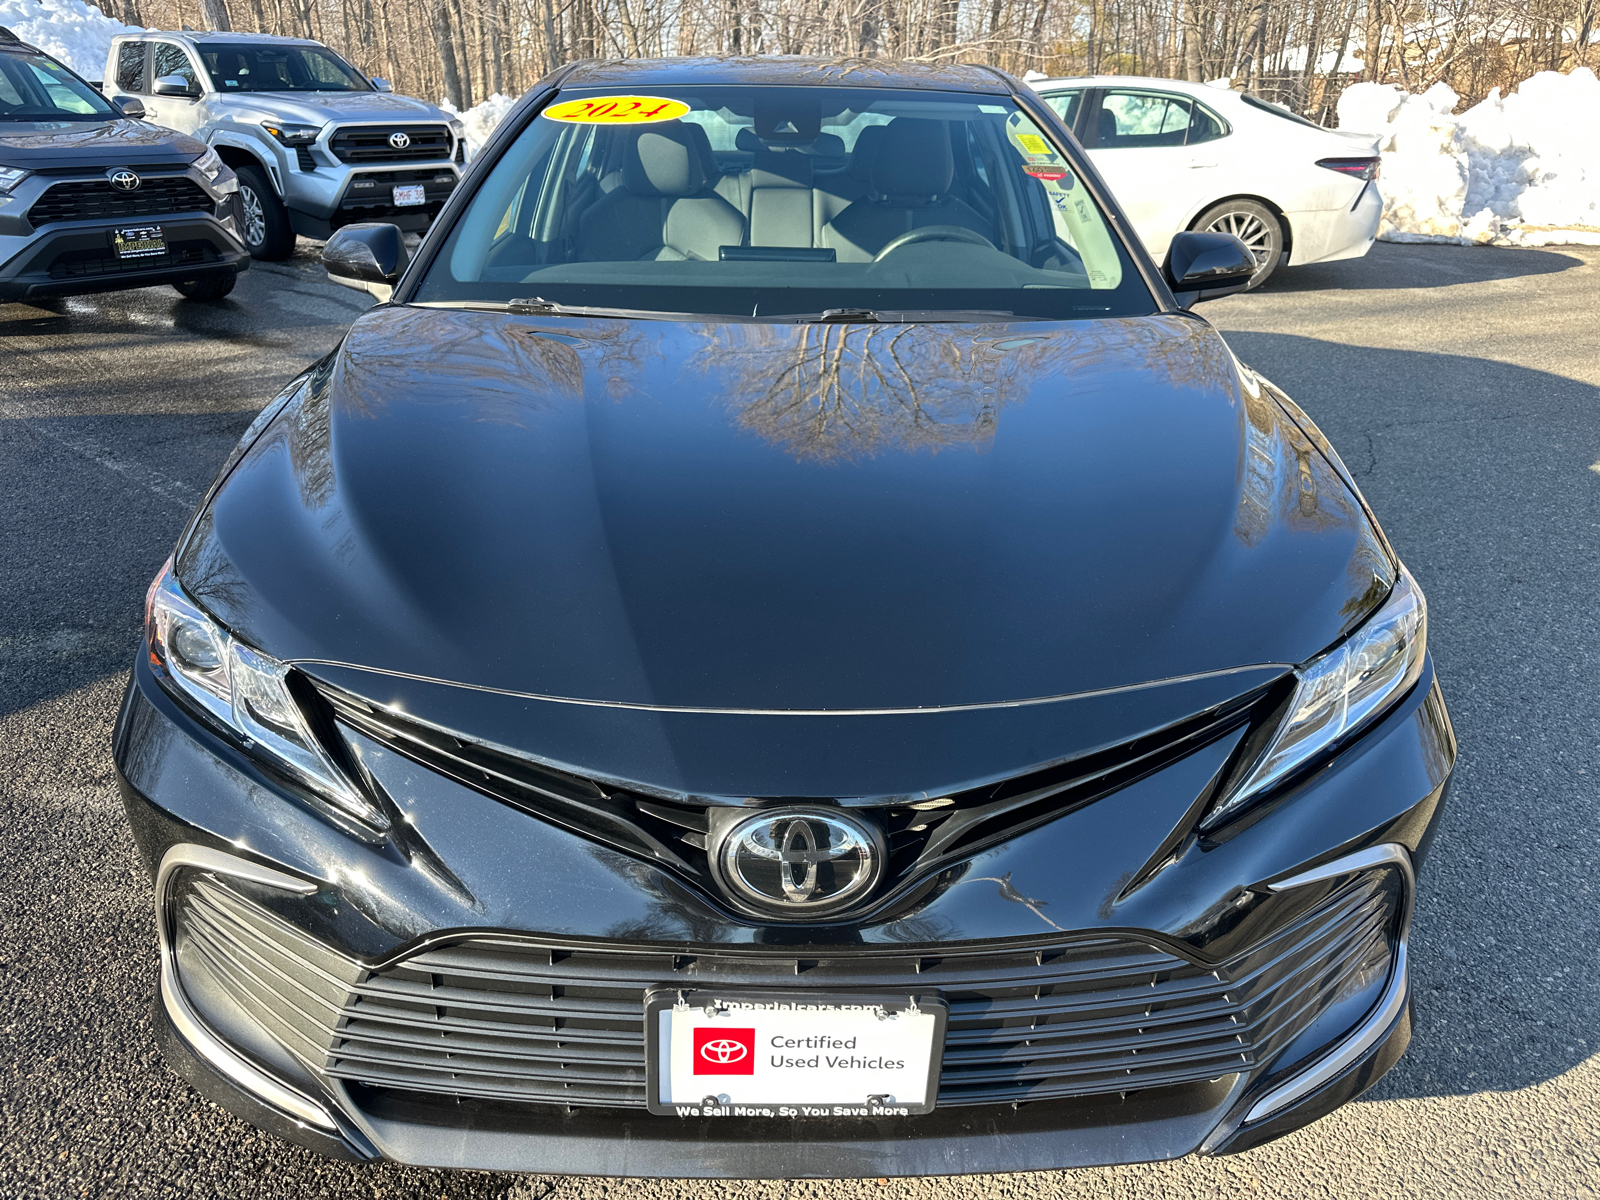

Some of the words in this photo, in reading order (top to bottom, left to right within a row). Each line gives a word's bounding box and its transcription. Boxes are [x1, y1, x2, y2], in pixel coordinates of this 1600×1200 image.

[562, 102, 671, 118] 2024
[770, 1035, 857, 1050] Certified
[770, 1055, 819, 1068] Used
[825, 1055, 905, 1070] Vehicles
[676, 1106, 700, 1117] We
[703, 1106, 730, 1117] Sell
[734, 1106, 775, 1118] More,
[779, 1106, 798, 1118] So
[802, 1106, 829, 1117] You
[833, 1106, 868, 1116] Save
[872, 1106, 909, 1116] More
